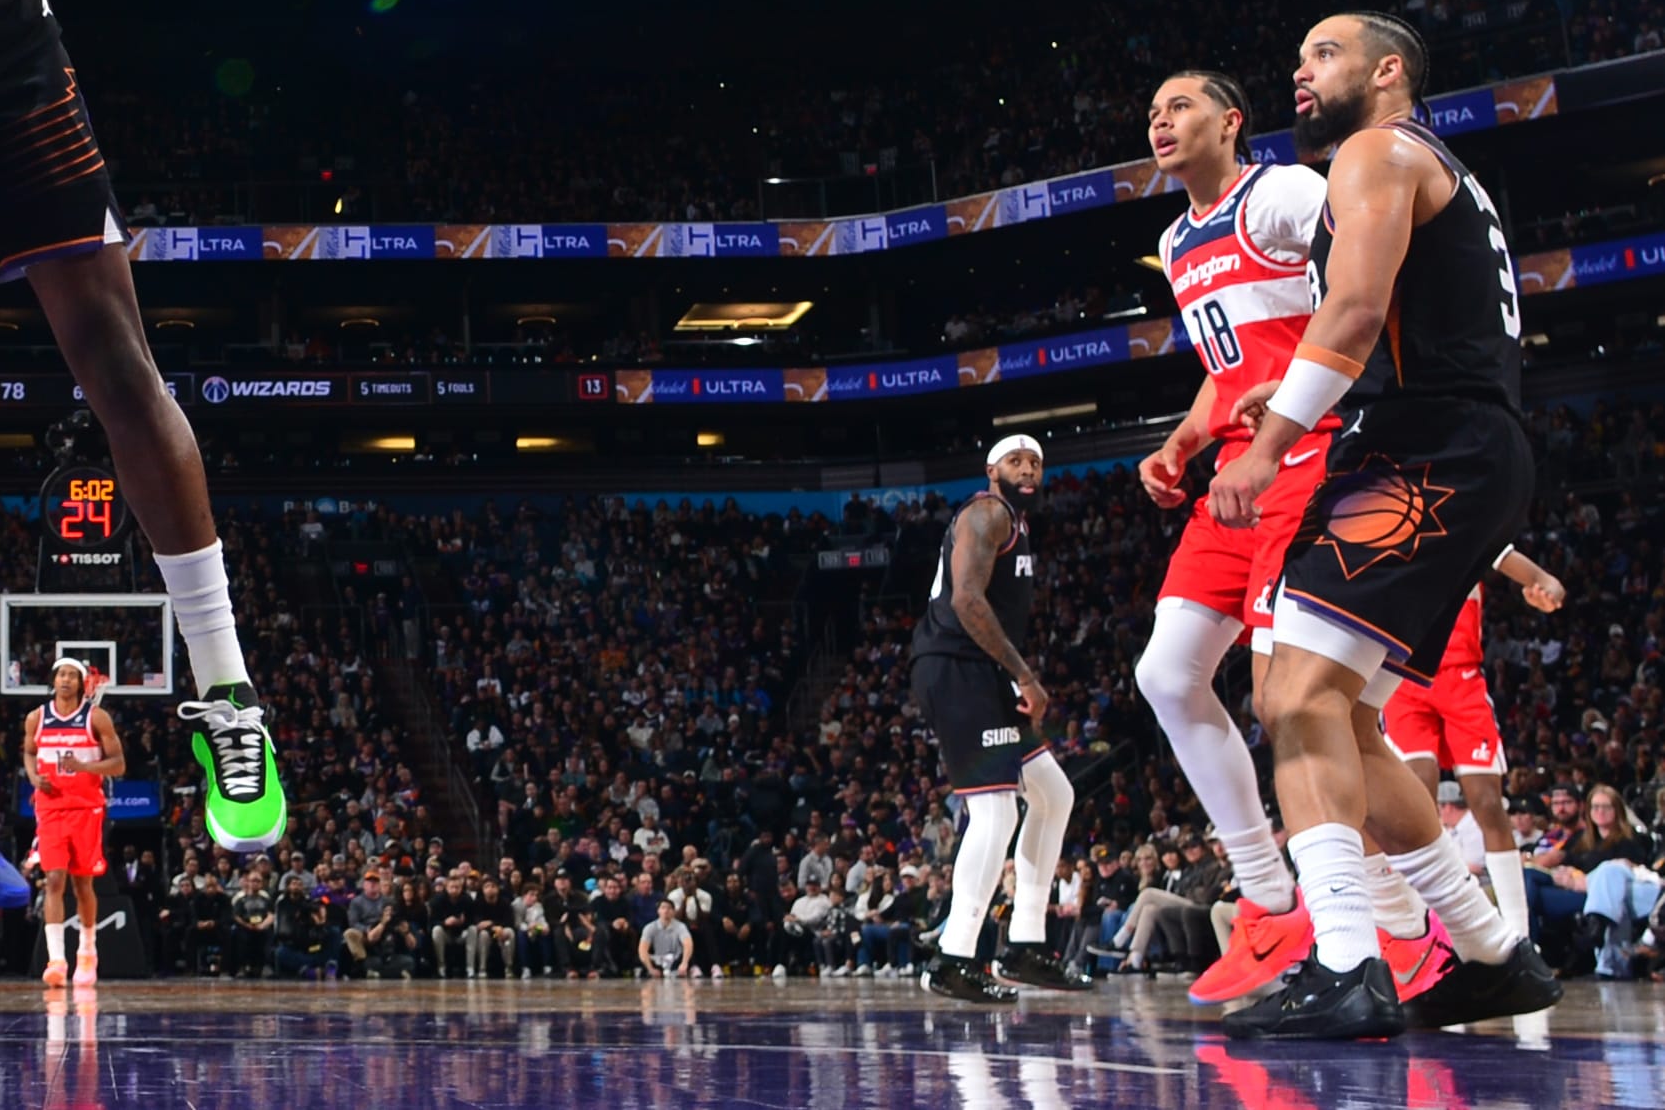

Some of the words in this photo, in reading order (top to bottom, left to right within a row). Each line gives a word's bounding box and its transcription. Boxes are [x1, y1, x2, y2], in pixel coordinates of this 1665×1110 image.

[1173, 253, 1240, 295] ashington
[1191, 299, 1243, 374] 18
[1050, 341, 1111, 362] ULTRA
[585, 379, 602, 395] 13
[705, 379, 767, 394] ULTRA
[882, 369, 942, 388] ULTRA
[0, 382, 25, 401] 78
[232, 381, 331, 397] WIZARDS
[361, 382, 369, 396] 5
[372, 383, 412, 394] TIMEOUTS
[437, 382, 445, 396] 5
[448, 383, 474, 393] FOULS
[69, 479, 115, 502] 6:02
[60, 502, 112, 539] 24
[69, 553, 122, 565] TISSOT
[982, 726, 1021, 748] SUNS
[107, 797, 151, 808] ps.com
